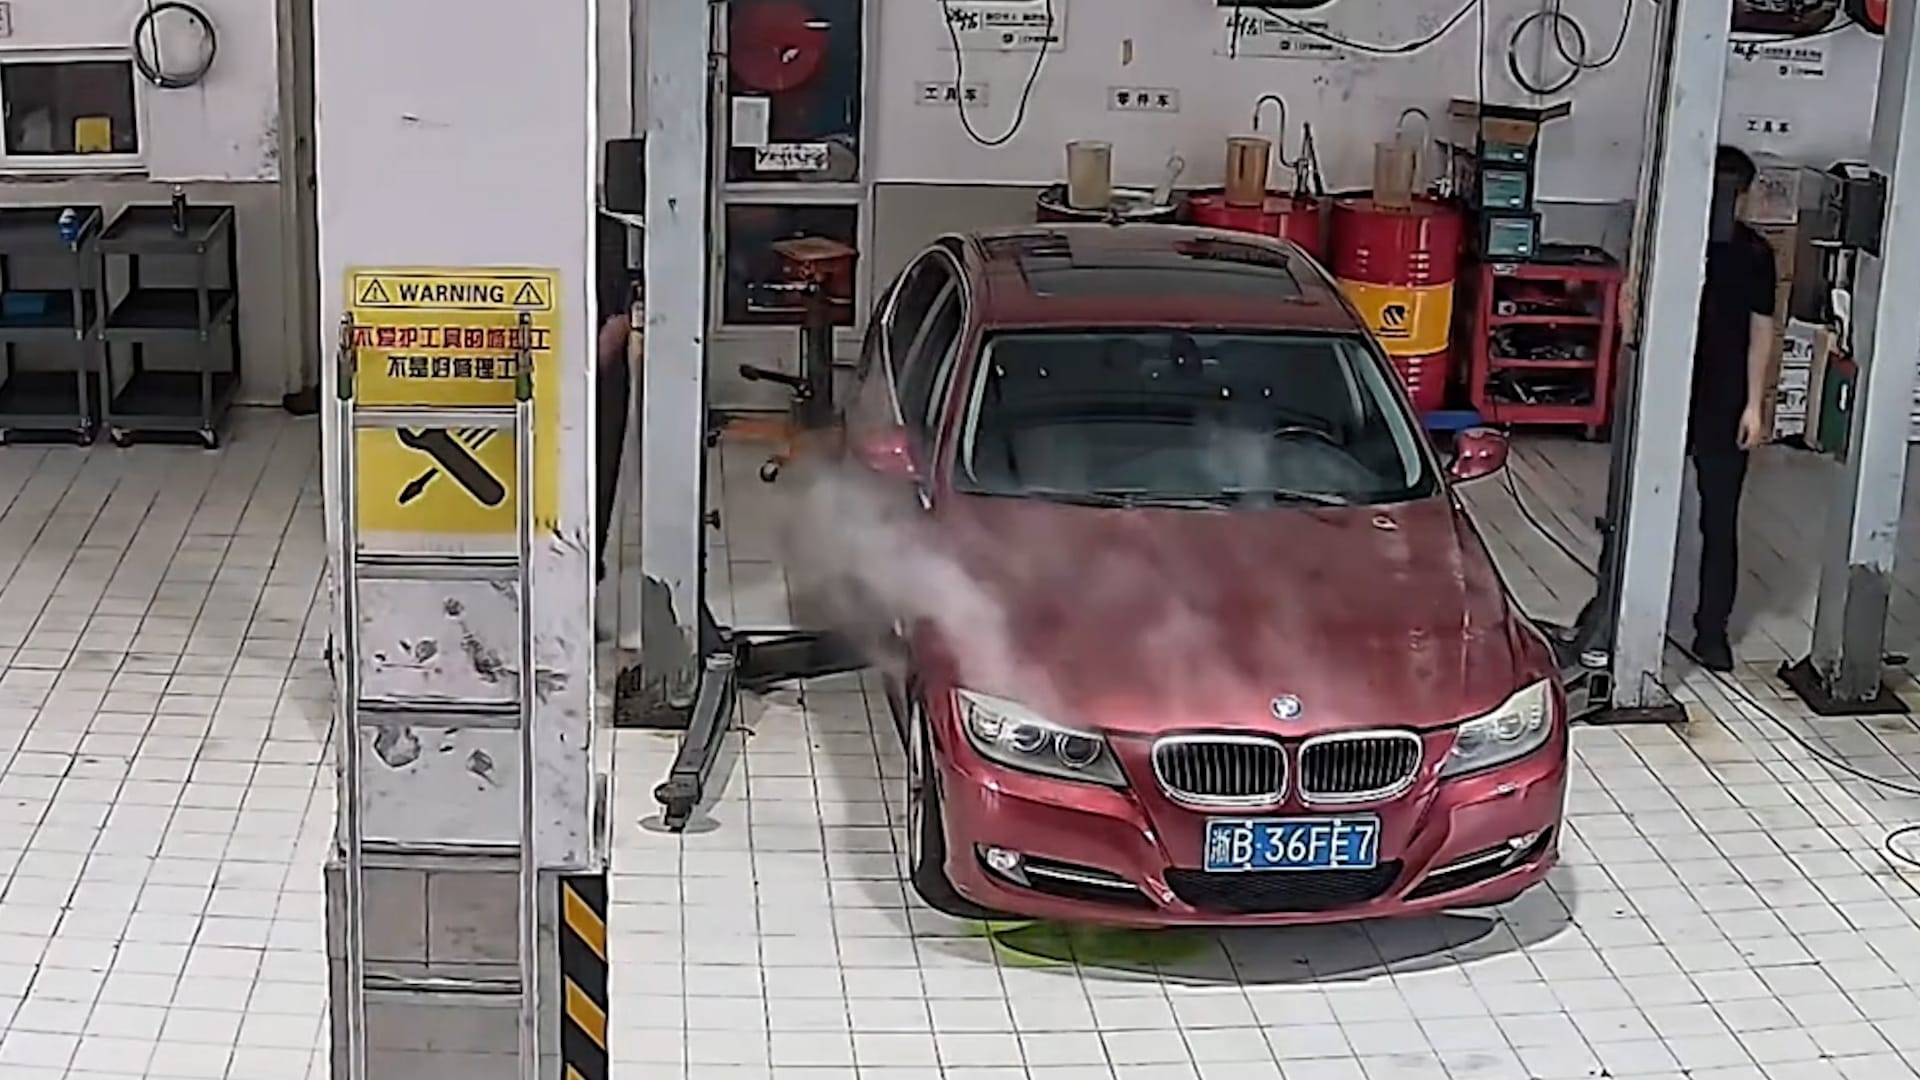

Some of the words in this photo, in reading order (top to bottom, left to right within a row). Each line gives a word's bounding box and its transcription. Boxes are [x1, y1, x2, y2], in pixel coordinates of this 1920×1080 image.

[400, 284, 504, 303] WARNING
[387, 356, 518, 379] 不是好修理工
